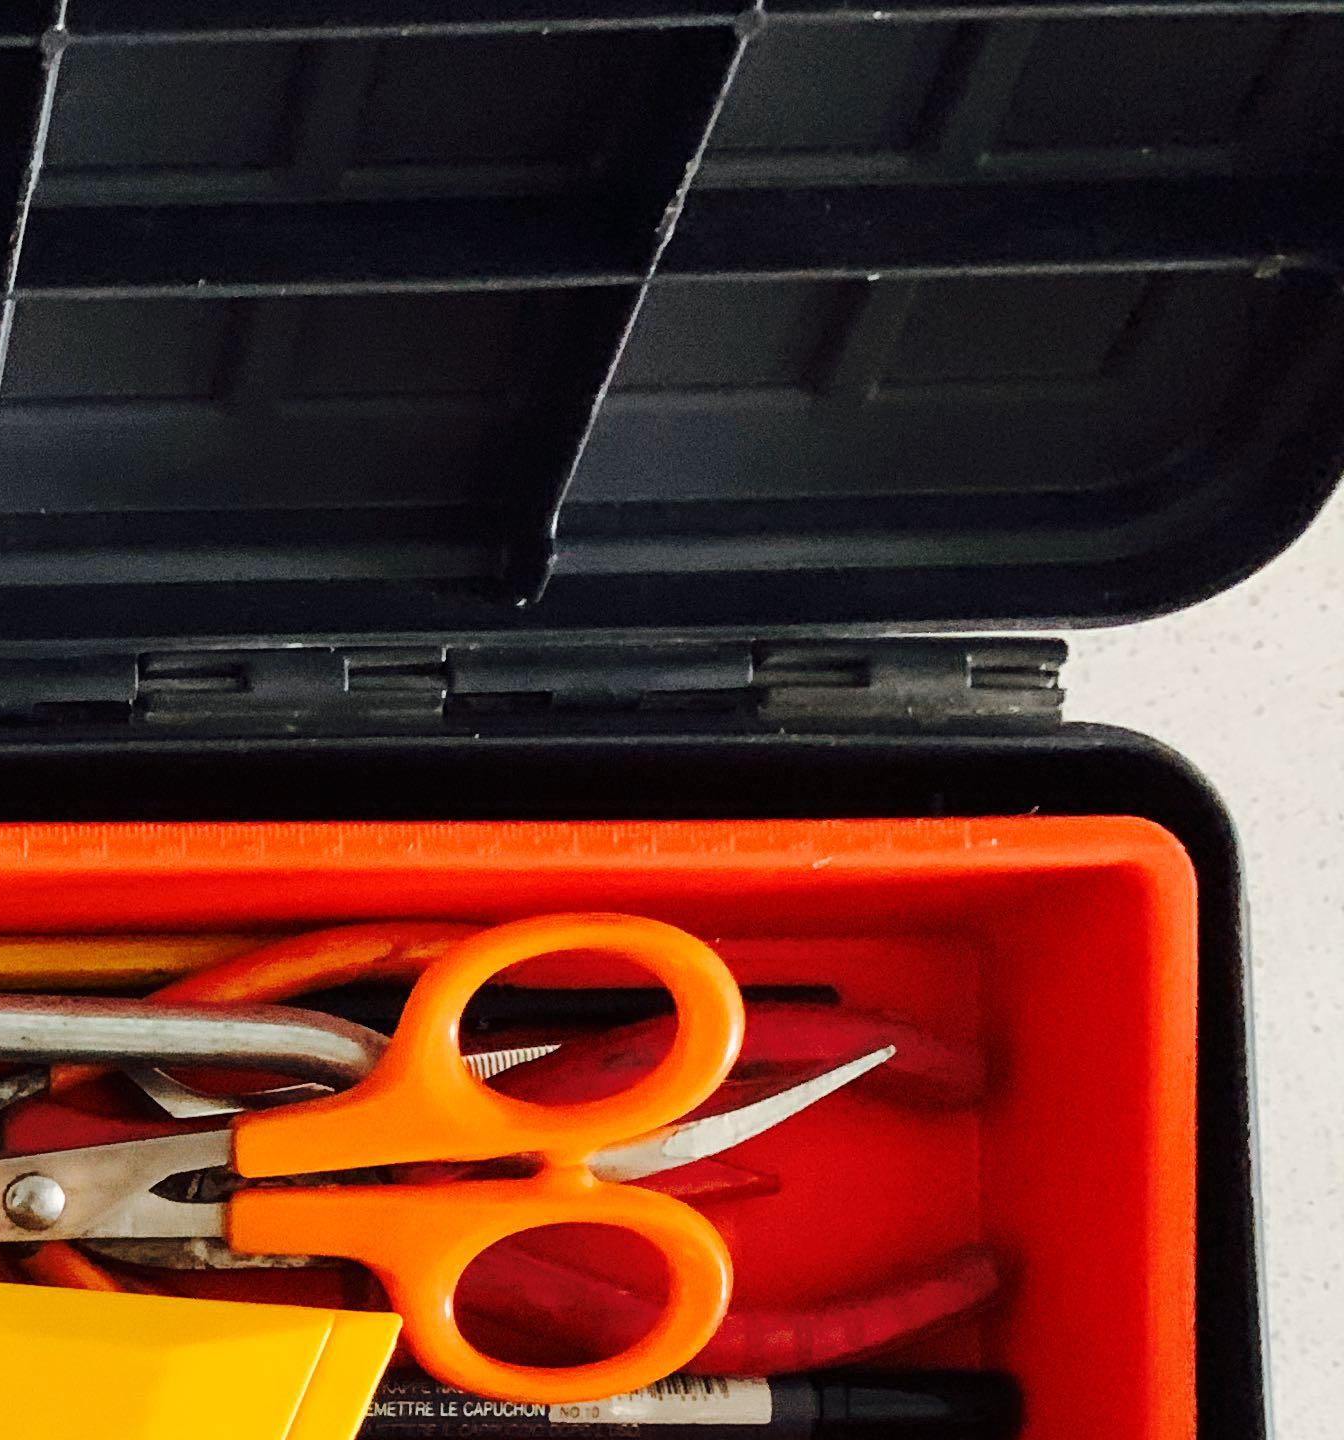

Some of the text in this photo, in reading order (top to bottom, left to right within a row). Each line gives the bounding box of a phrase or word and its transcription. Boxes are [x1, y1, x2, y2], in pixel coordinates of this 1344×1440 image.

[366, 1400, 546, 1418] EMETTRE LE CAPUCHON
